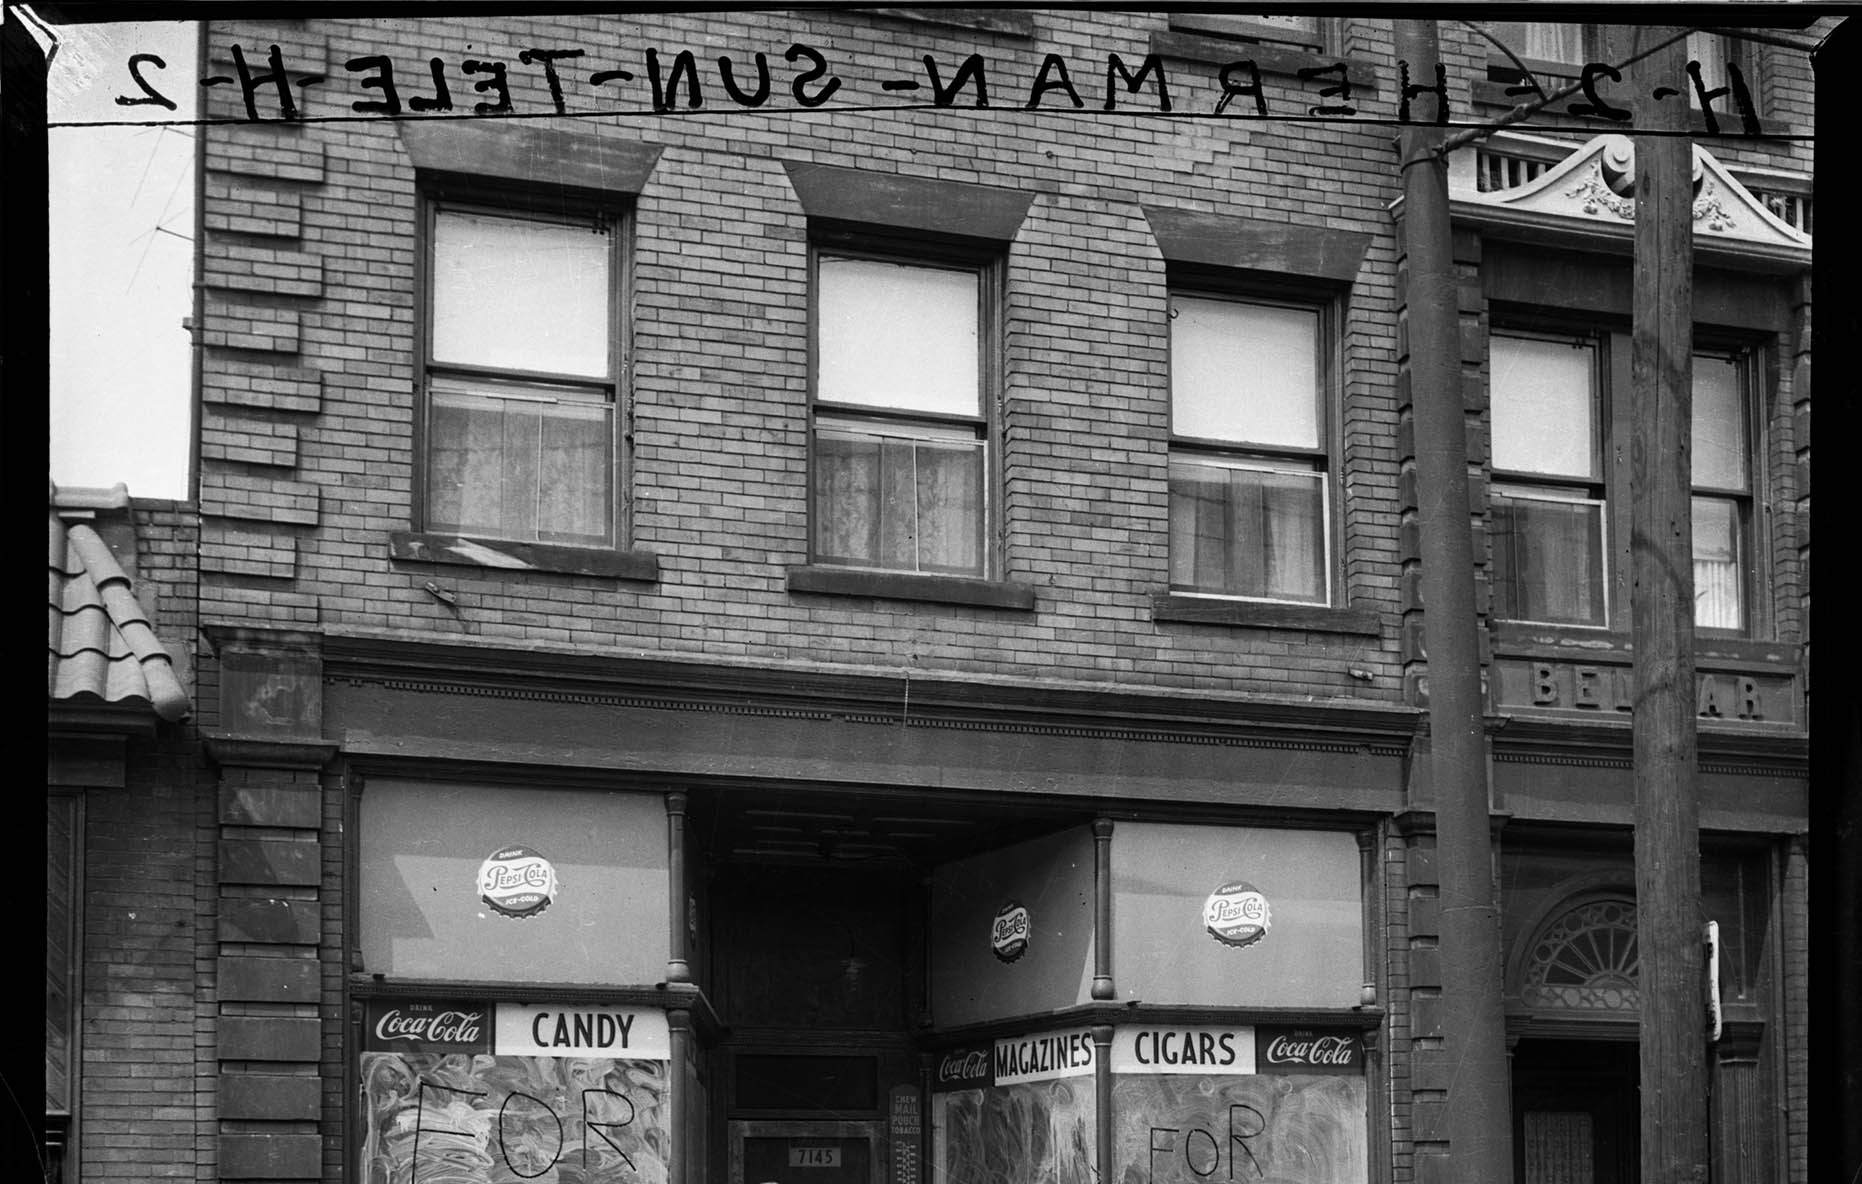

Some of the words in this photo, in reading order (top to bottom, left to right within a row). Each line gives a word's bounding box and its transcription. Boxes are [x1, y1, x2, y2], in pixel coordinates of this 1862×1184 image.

[375, 1009, 484, 1042] Coca-Cola
[532, 1012, 635, 1050] CANDY
[996, 1032, 1092, 1078] MAGAZINES
[1134, 1031, 1236, 1066] CIGARS
[1266, 1035, 1355, 1064] Coca-Cola
[939, 1050, 988, 1082] Coca-Cola
[892, 1116, 919, 1125] POUCH
[895, 1104, 918, 1114] MAIL
[891, 1126, 921, 1134] TOBACCO
[798, 1148, 833, 1164] 7145
